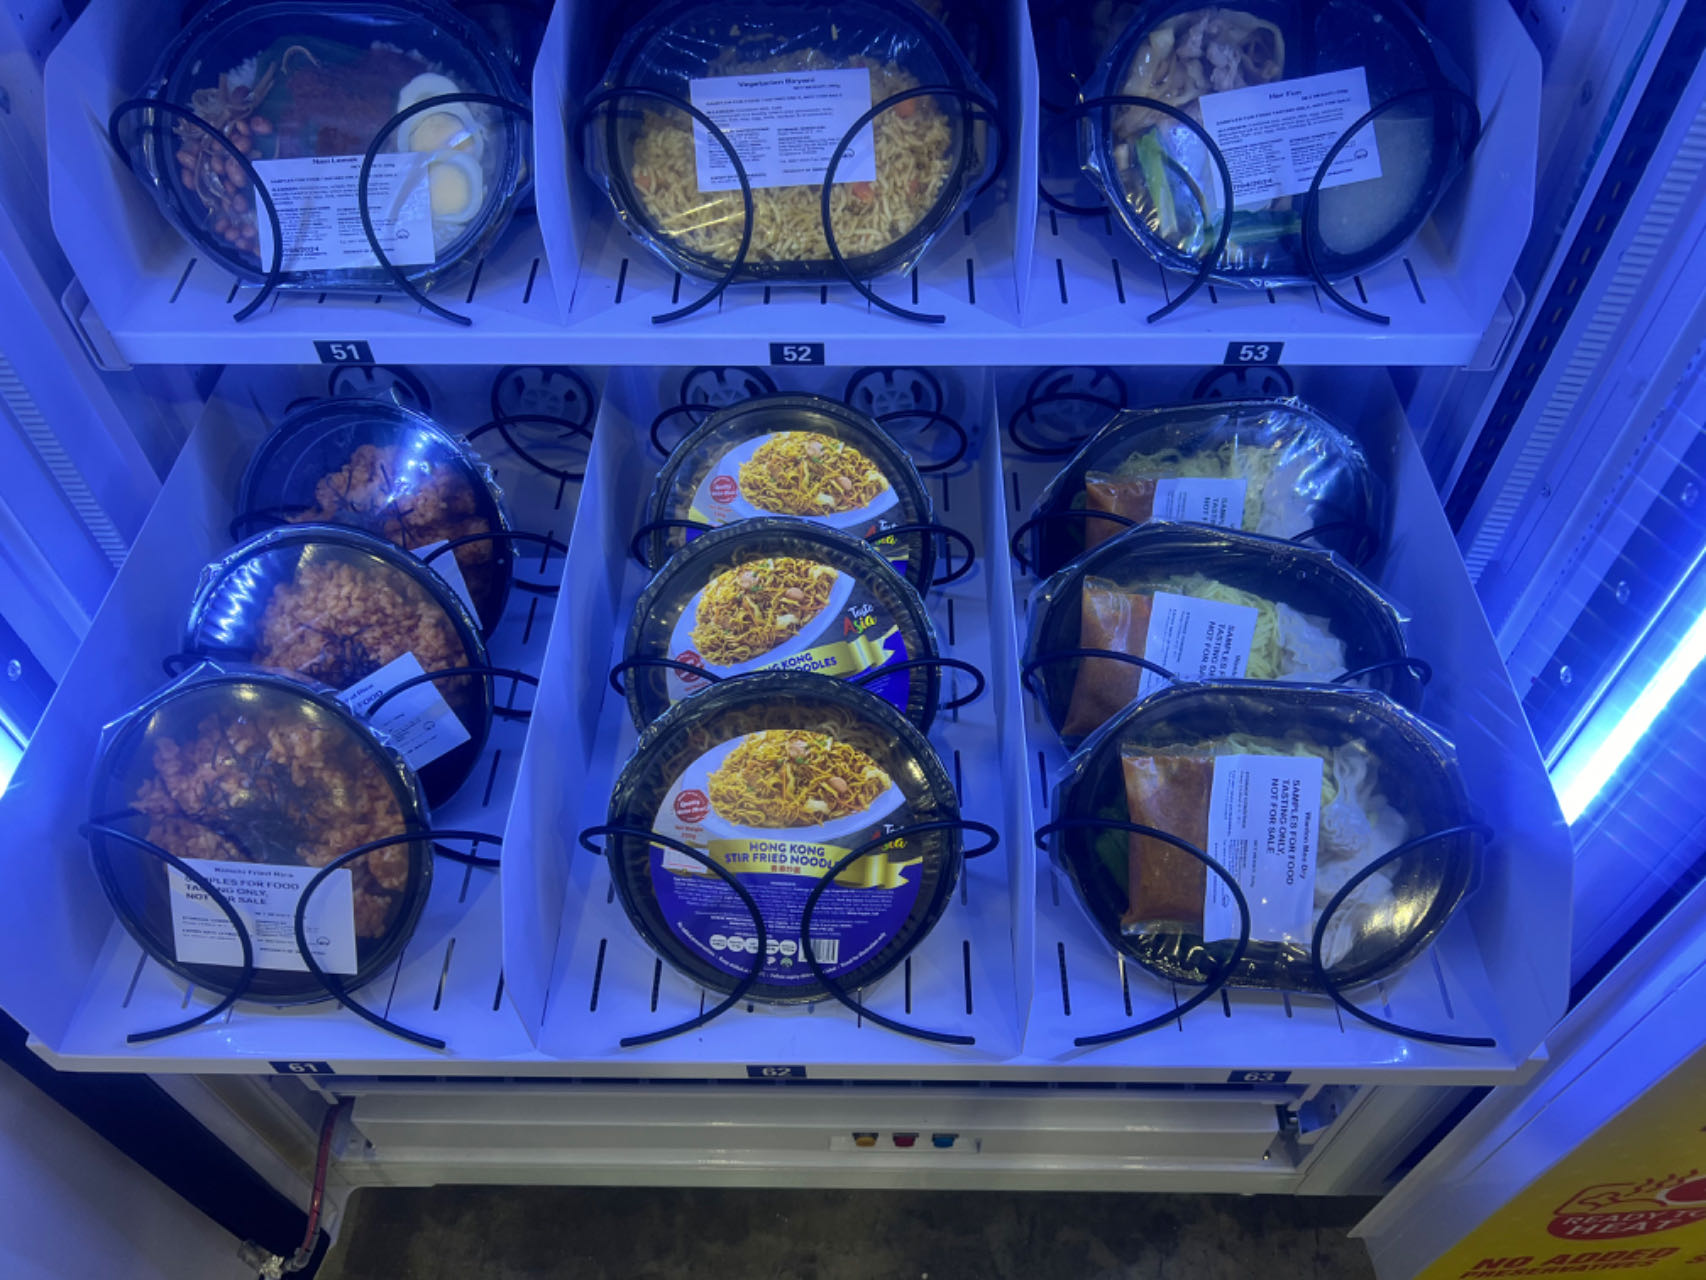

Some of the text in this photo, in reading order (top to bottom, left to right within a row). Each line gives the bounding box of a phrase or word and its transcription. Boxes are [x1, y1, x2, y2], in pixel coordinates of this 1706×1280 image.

[330, 344, 360, 360] 51
[783, 346, 812, 361] 52
[1239, 345, 1270, 361] 53
[848, 604, 874, 618] Taste
[843, 615, 877, 637] Asia
[1206, 621, 1216, 642] NOT
[1212, 623, 1226, 664] TASTING
[1220, 625, 1235, 670] SAMPLES
[781, 652, 813, 670] KONG
[1203, 643, 1211, 663] FOR
[794, 656, 837, 672] OODLES
[1266, 778, 1279, 854] NOT FOR SALE
[1275, 779, 1290, 856] TASTING ONLY,
[1286, 780, 1301, 886] SAMPLES FOR FOOD
[749, 842, 825, 857] HONG KONG
[725, 852, 750, 863] STIR
[753, 853, 788, 864] FRIED
[240, 879, 264, 888] FOR
[266, 880, 300, 890] FOOD
[186, 893, 210, 901] NOT
[238, 897, 268, 905] SALE
[289, 1063, 318, 1072] 61
[762, 1067, 791, 1076] 62
[1244, 1072, 1275, 1081] 63
[1562, 1208, 1706, 1225] READY TO
[1565, 1220, 1674, 1236] HEAT
[1471, 1256, 1535, 1270] NO
[1540, 1247, 1681, 1267] ADDED
[1459, 1259, 1659, 1279] PRESERVATIVES
